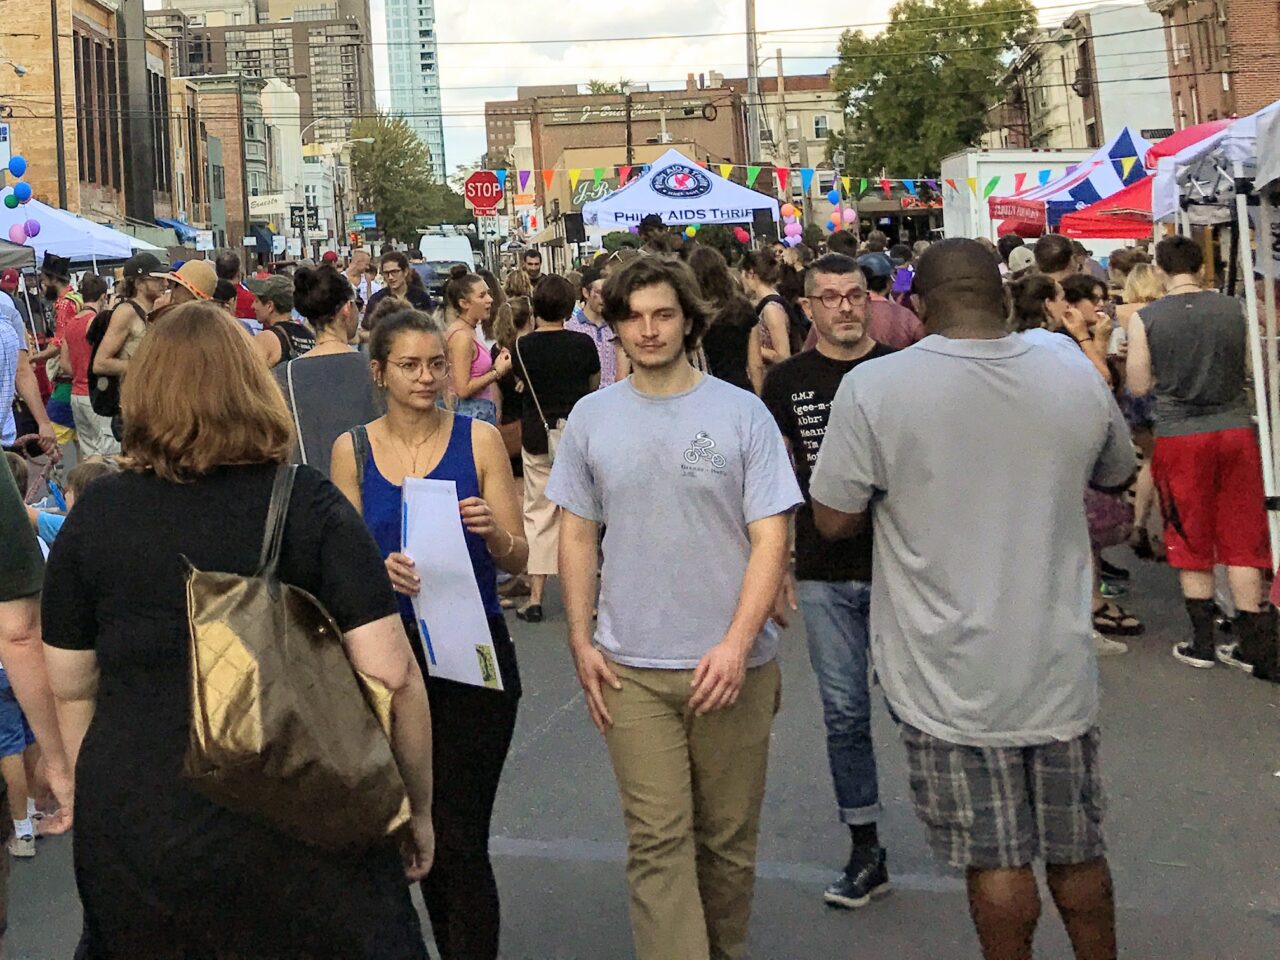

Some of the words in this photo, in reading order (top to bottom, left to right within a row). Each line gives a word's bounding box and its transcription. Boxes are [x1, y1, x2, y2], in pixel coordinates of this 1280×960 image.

[467, 182, 501, 198] STOP
[614, 211, 663, 222] PHIY
[668, 209, 707, 221] AIDS
[709, 208, 753, 219] THRIF
[798, 415, 823, 426] Abbr:
